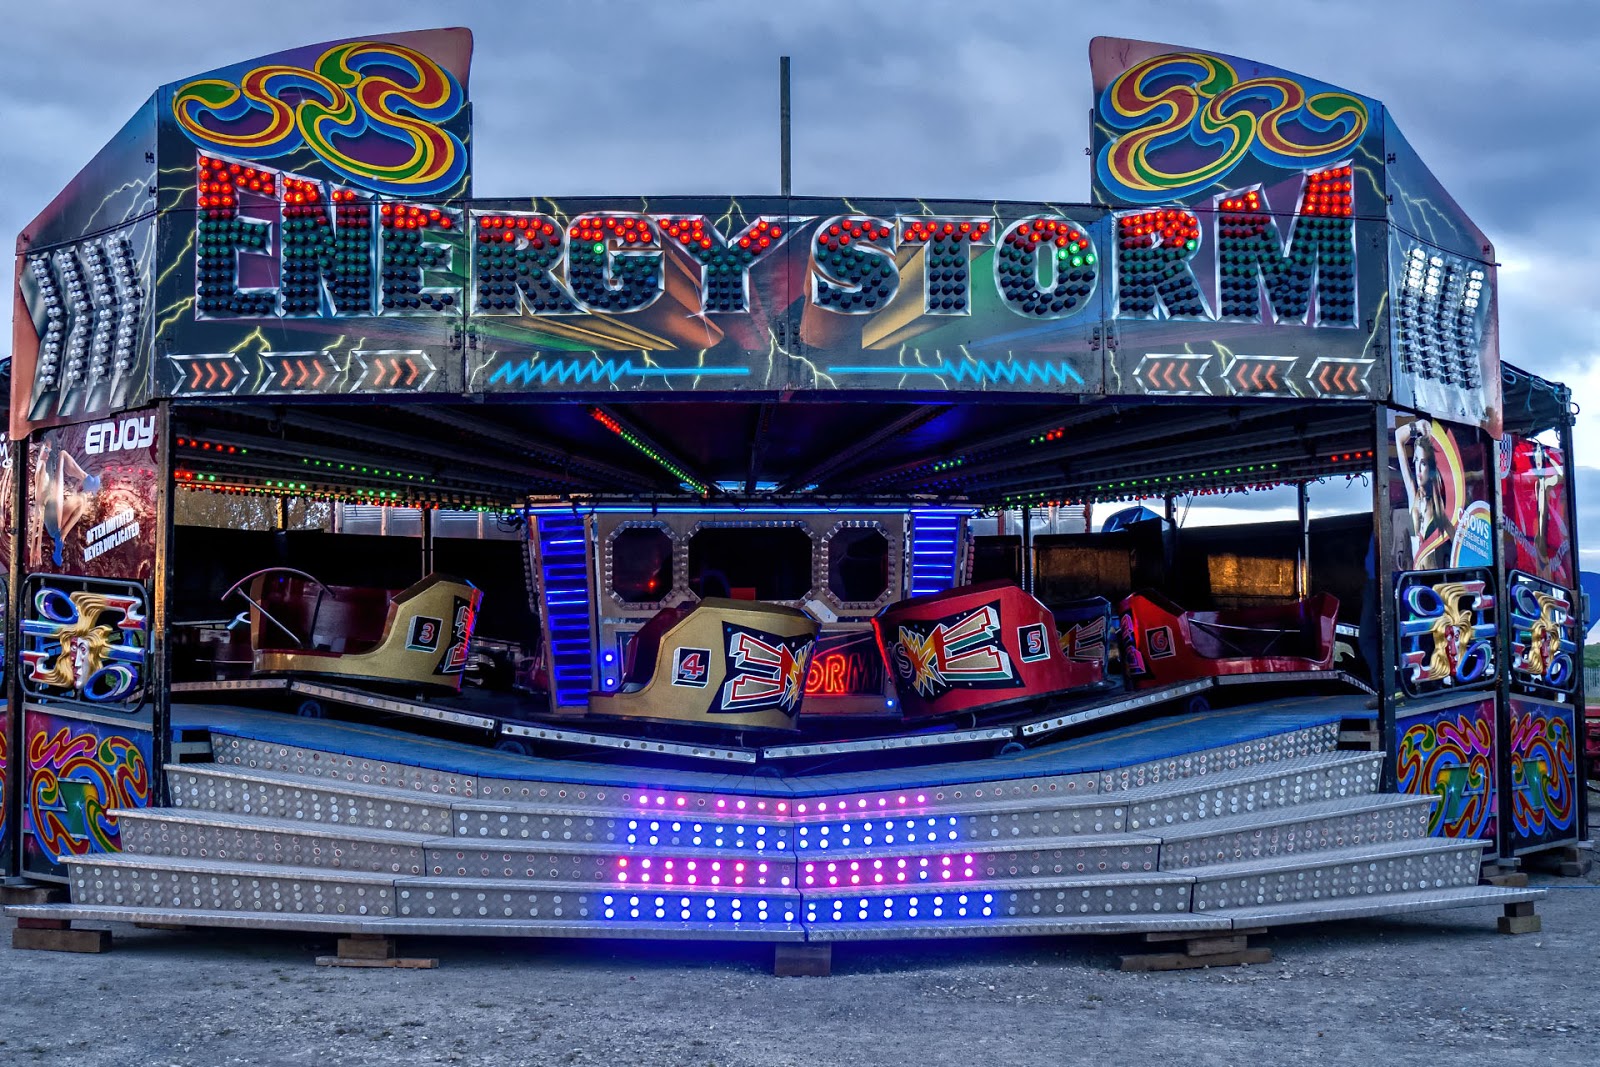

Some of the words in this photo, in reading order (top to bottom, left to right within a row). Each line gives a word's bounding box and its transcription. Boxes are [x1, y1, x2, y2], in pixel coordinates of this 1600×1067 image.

[194, 149, 817, 322] ENERGY
[810, 159, 1360, 329] STORM
[85, 416, 156, 455] ENJOY
[419, 622, 435, 644] 3
[1027, 630, 1041, 653] 5
[1151, 630, 1168, 652] 6
[679, 653, 705, 680] 4
